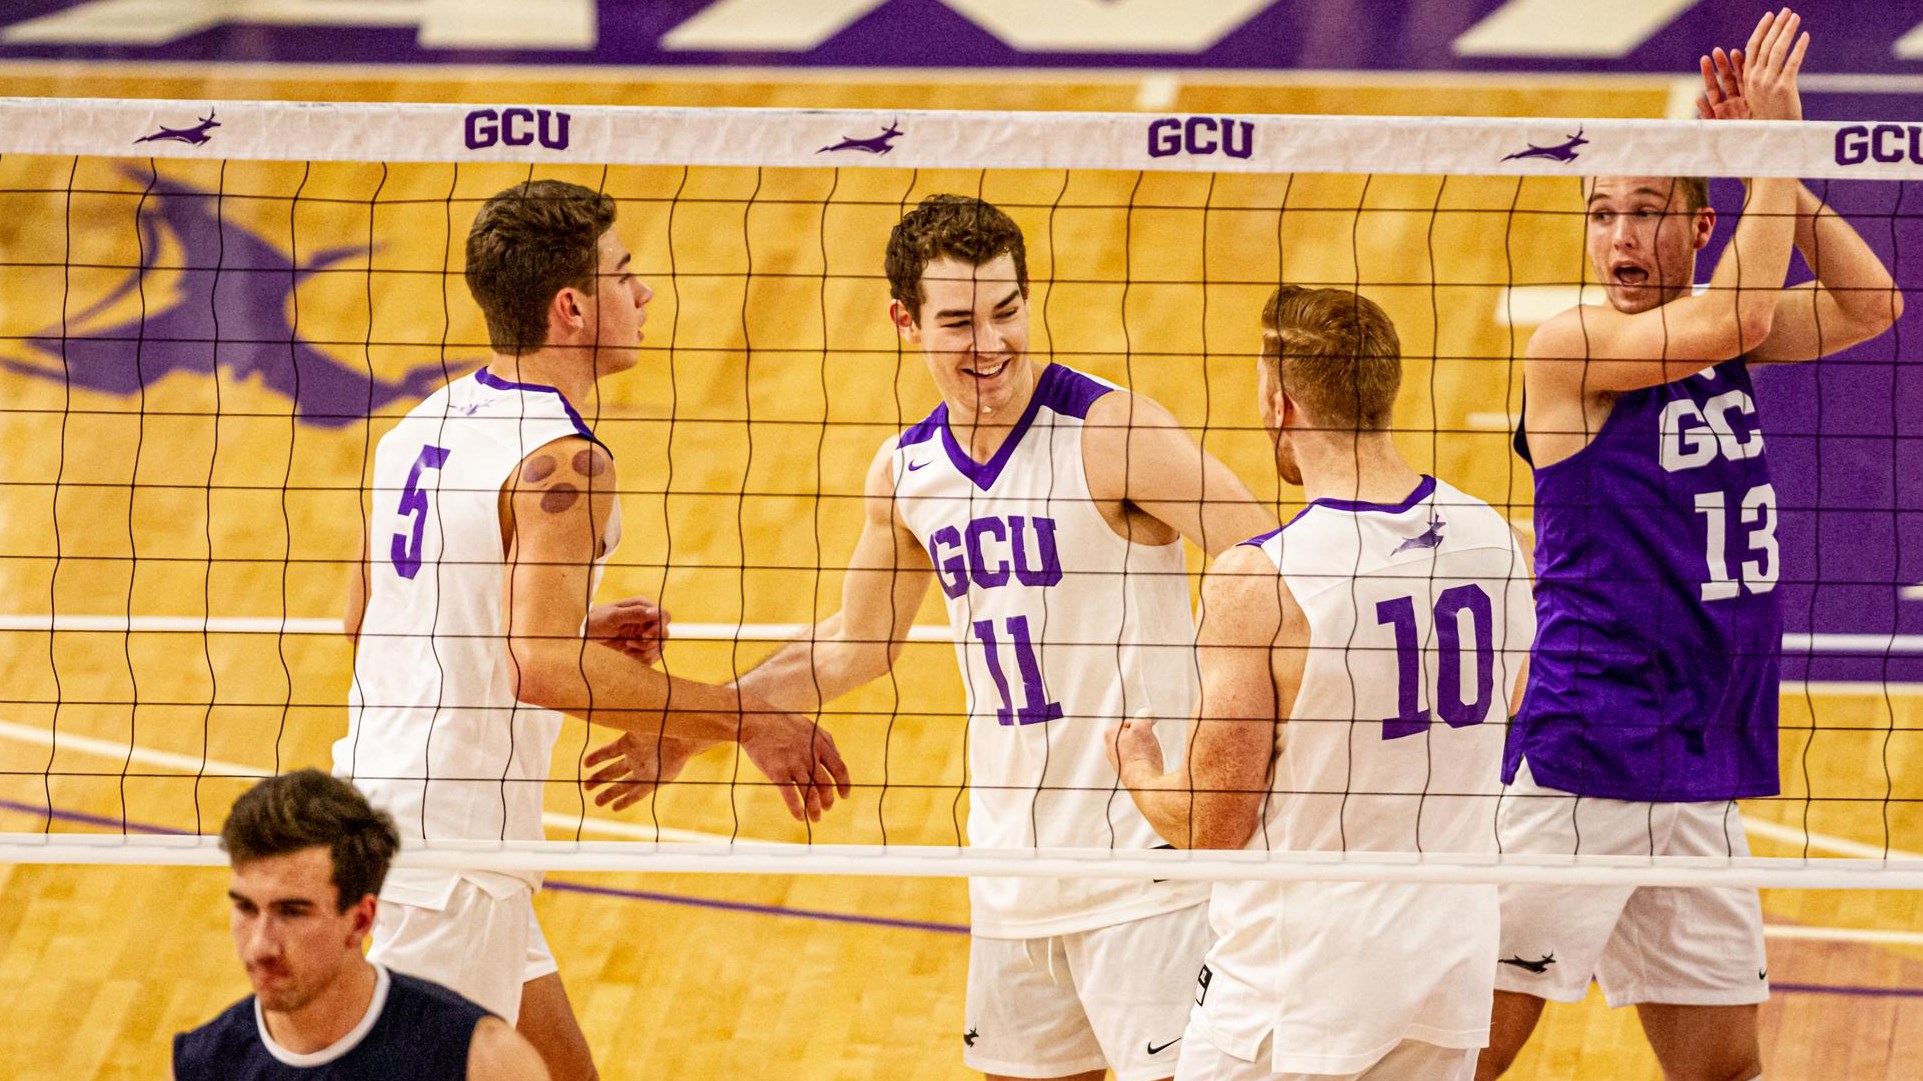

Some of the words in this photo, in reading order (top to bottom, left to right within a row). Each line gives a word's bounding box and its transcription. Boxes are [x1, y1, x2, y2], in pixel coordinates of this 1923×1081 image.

[465, 108, 571, 150] GCU
[1147, 117, 1255, 159] GCU
[1659, 389, 1766, 473] GC
[391, 444, 451, 580] 5
[929, 516, 1063, 600] GCU
[1694, 483, 1780, 601] 13
[973, 615, 1064, 726] 11
[1376, 583, 1494, 740] 10
